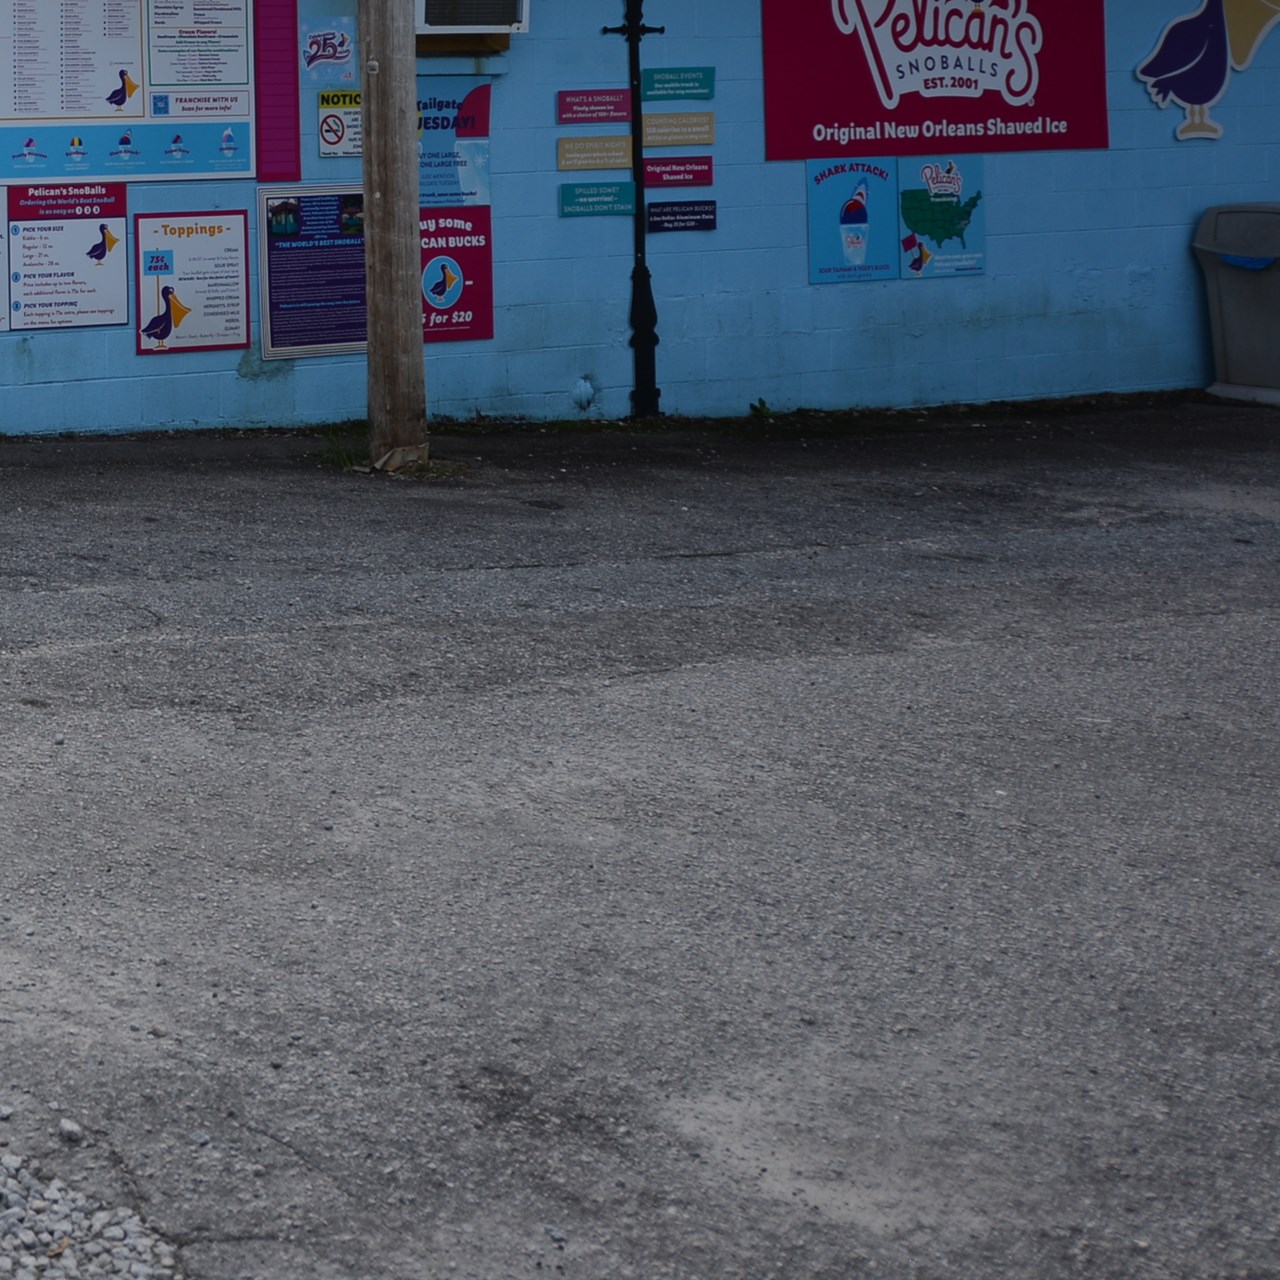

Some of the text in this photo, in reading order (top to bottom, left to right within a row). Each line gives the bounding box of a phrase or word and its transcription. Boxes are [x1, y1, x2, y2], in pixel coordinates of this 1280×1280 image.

[307, 35, 338, 68] 25
[896, 54, 999, 80] SNOBALLS
[923, 77, 979, 90] EST. 2001
[321, 94, 361, 106] NOTIC
[566, 95, 587, 103] WHAT'S
[593, 94, 623, 102] SNOBALL?
[417, 115, 475, 132] UESDAY!
[812, 116, 1068, 145] Original New Orleans Shaved Ice
[433, 160, 452, 168] LARGE
[646, 163, 708, 174] Original New Orleans
[662, 173, 682, 181] Shaved
[814, 162, 890, 185] SHARK ATTACK!
[922, 164, 961, 195] Pelican's
[28, 186, 106, 197] Pelican's SnoBalls
[20, 198, 46, 207] Ordering
[91, 196, 115, 204] SnoBall
[161, 223, 223, 237] Toppings
[420, 218, 472, 232] uy some
[448, 235, 486, 249] BUCKS
[148, 263, 169, 271] each
[429, 312, 447, 327] for
[451, 311, 473, 324] $20
